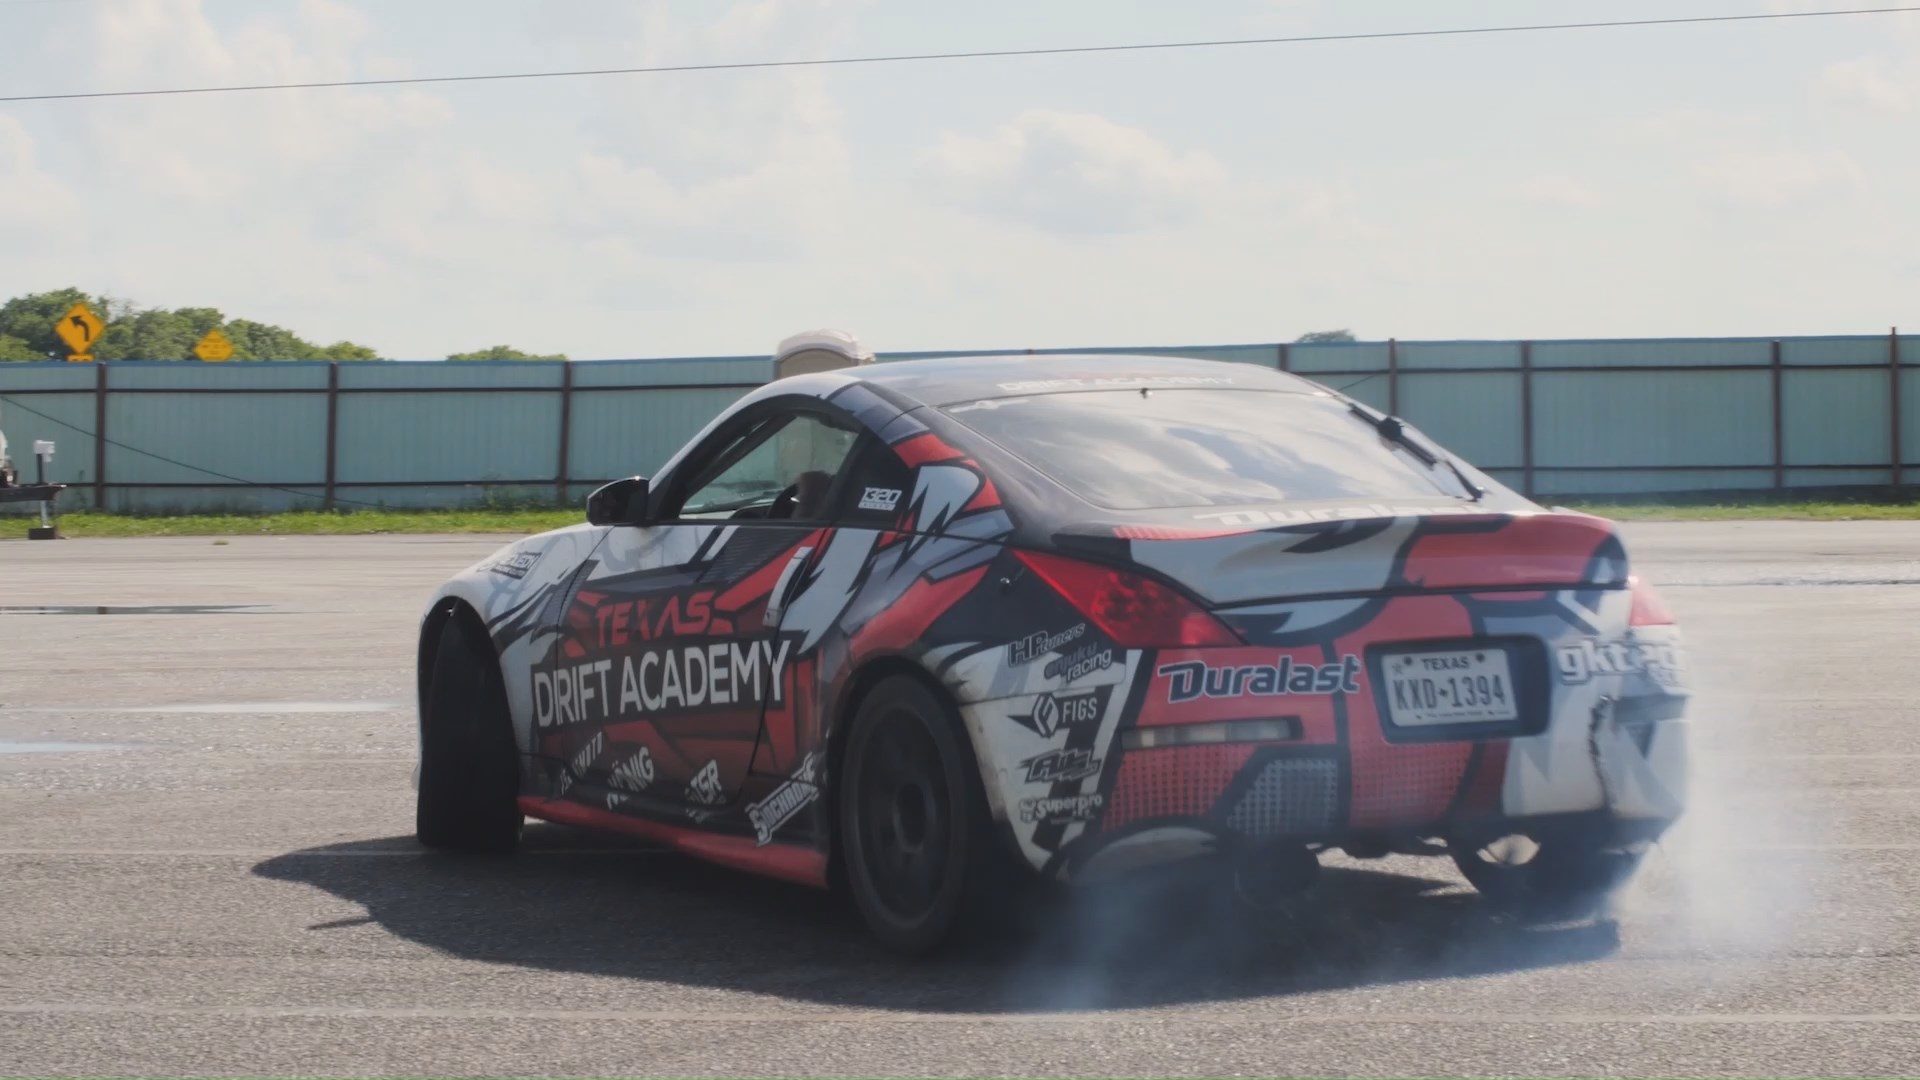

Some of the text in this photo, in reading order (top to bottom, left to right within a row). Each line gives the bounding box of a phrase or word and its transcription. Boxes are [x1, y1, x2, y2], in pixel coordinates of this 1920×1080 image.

[861, 487, 902, 504] 1320
[595, 591, 712, 648] TEXAS
[1067, 648, 1112, 683] racing
[1157, 654, 1361, 704] Duralast
[1421, 655, 1470, 671] TEXAS
[534, 639, 793, 727] DRIFT ACADEMY
[1062, 697, 1098, 724] FIGS
